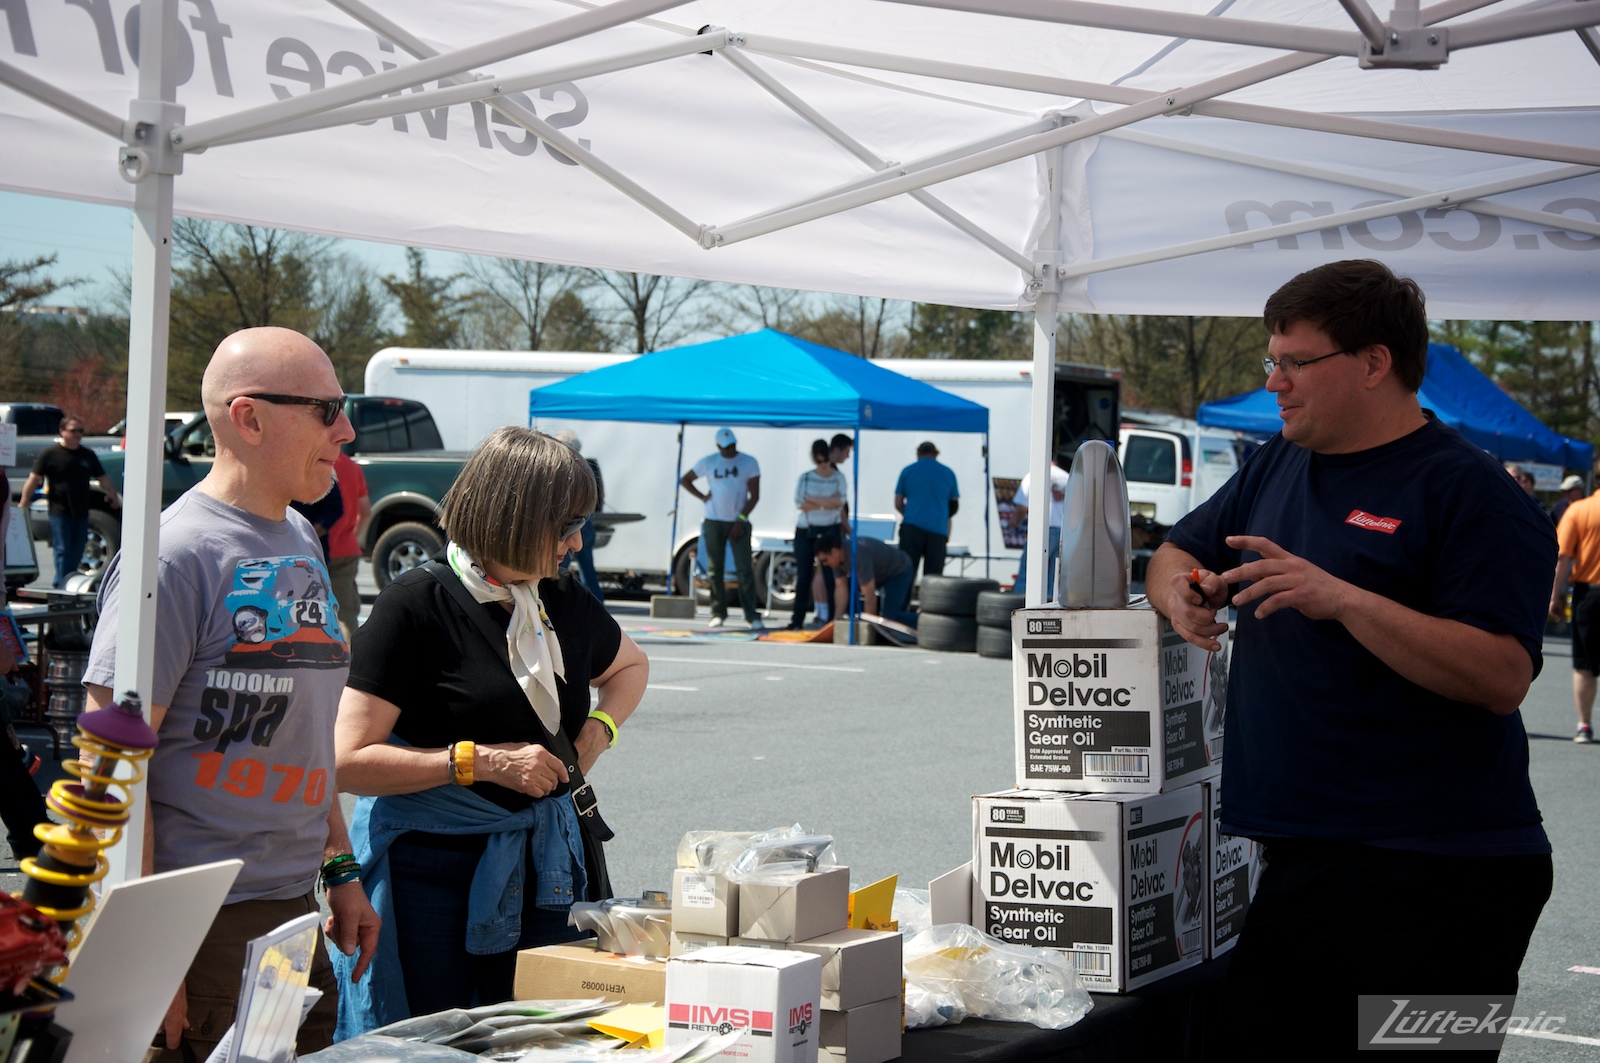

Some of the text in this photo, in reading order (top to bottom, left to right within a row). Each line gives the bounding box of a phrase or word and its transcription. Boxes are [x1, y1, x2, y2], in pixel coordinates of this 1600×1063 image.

[1029, 621, 1042, 633] 80
[1027, 653, 1107, 678] Mobil
[1164, 648, 1188, 677] Mobil
[205, 669, 294, 693] 1000km
[1165, 678, 1195, 706] Delvac
[1028, 681, 1131, 707] Delvac
[1028, 714, 1103, 731] Synthetic
[1029, 731, 1095, 746] Gear Oil
[191, 752, 328, 806] 1970
[1030, 764, 1071, 773] SAE 75W-90
[992, 808, 1005, 821] 80
[990, 842, 1070, 871] Mobil
[1130, 839, 1158, 871] Mobil
[1215, 845, 1242, 875] Delvac
[990, 871, 1094, 902] Delvac
[1130, 871, 1165, 900] Delvac
[990, 905, 1065, 924] Synthetic
[990, 923, 1057, 941] Gear Oil
[581, 980, 626, 994] VER100092
[692, 1005, 749, 1027] IMS
[789, 1002, 812, 1027] IMS
